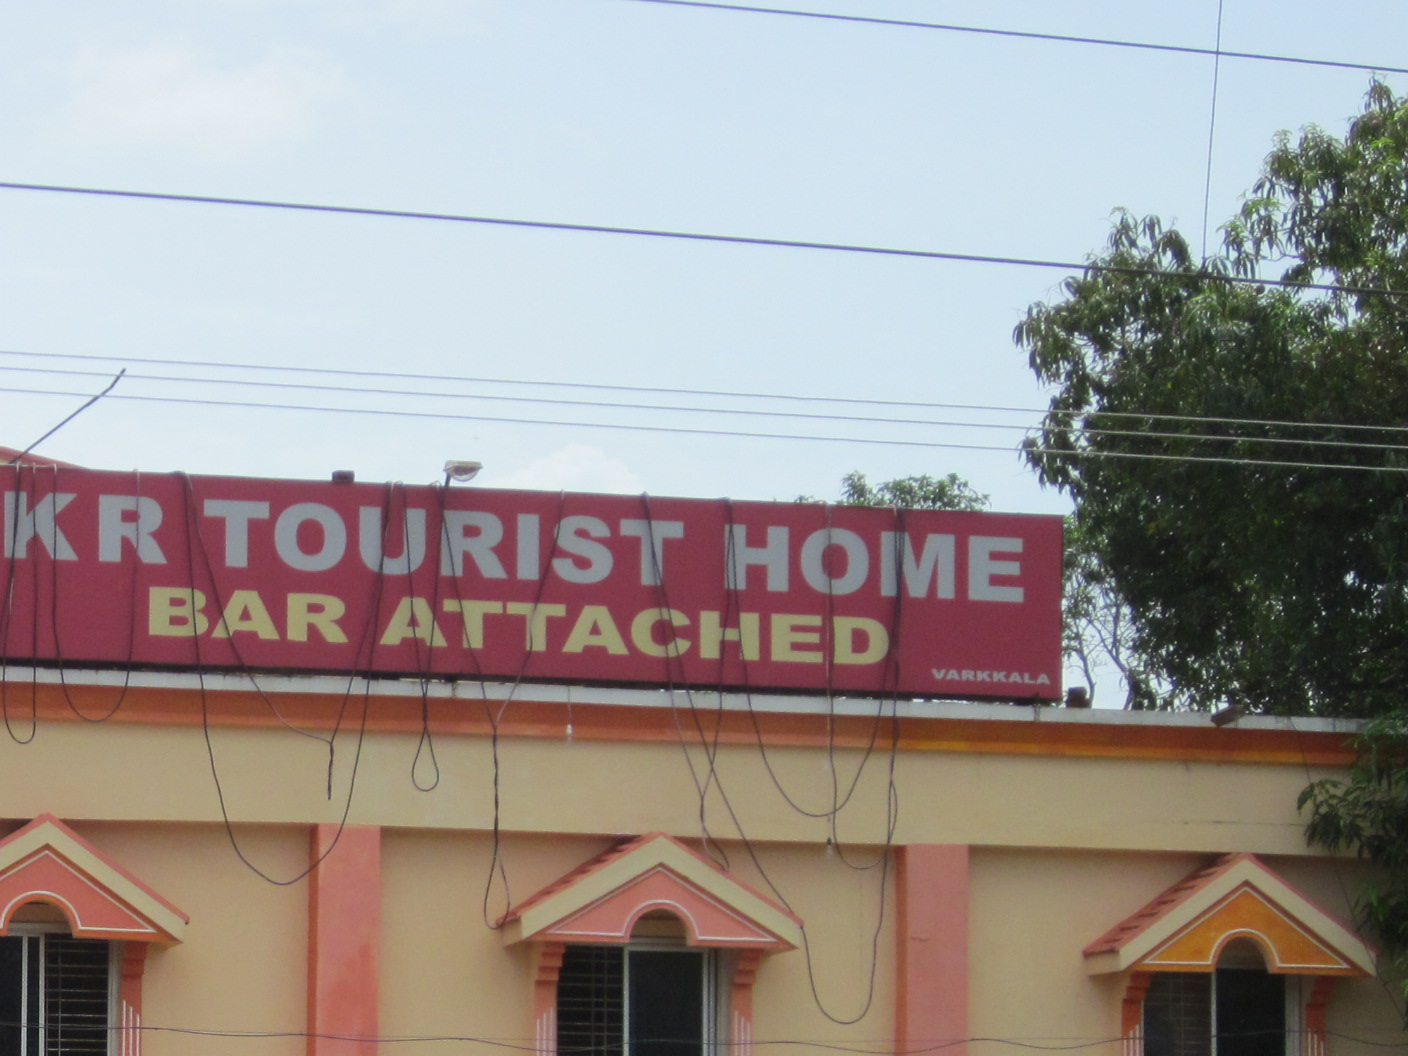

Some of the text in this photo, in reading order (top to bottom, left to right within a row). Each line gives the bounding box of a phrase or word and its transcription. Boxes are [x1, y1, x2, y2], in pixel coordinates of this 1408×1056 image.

[3, 491, 1025, 603] K R TOURIST HOME
[148, 585, 890, 666] BAR ATTACHED
[931, 668, 1051, 685] VARKKALA
